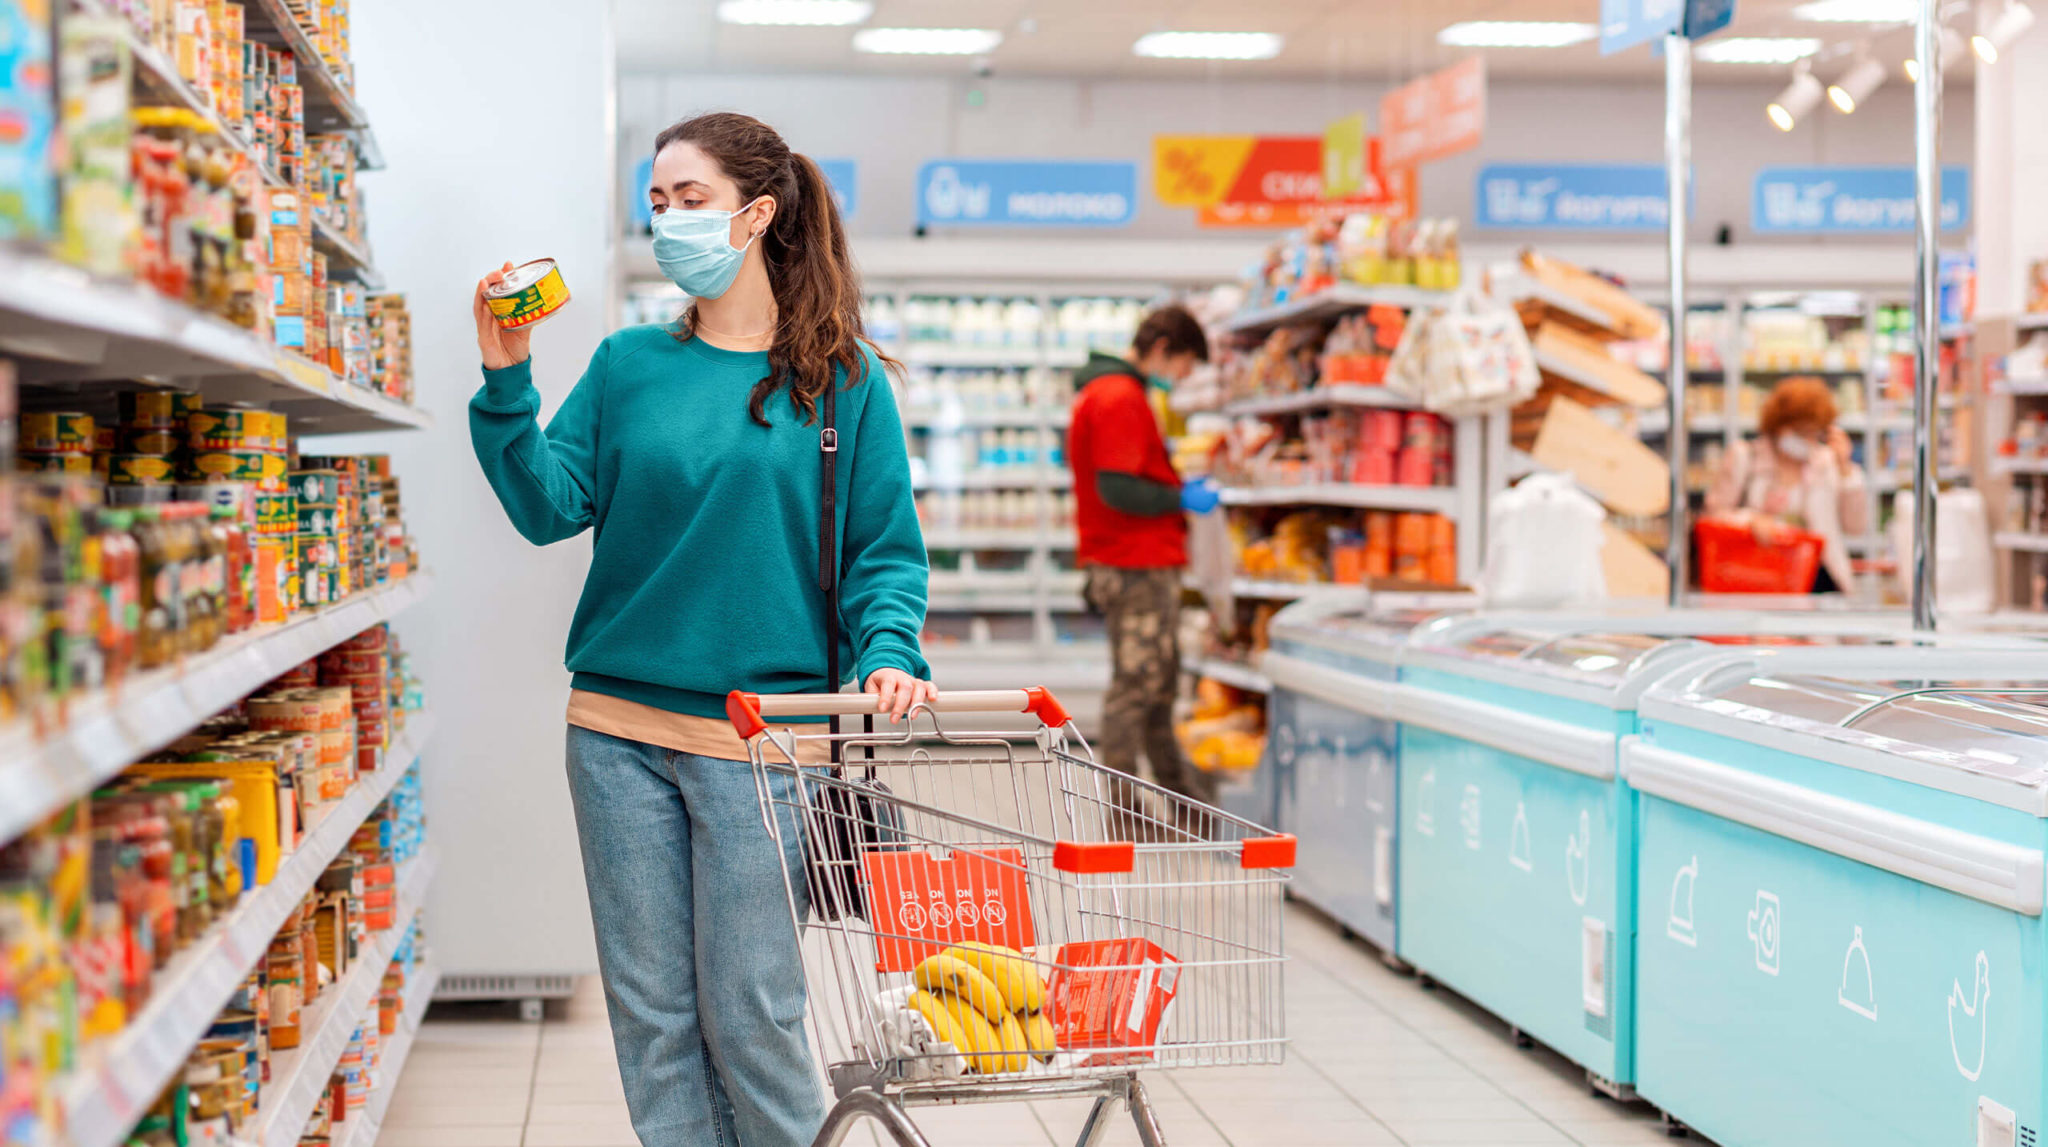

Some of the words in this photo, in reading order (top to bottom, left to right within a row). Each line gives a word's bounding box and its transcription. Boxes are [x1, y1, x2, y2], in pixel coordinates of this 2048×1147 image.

[900, 890, 920, 900] YES
[929, 890, 944, 899] NO
[957, 889, 972, 898] NO
[984, 888, 999, 897] NO
